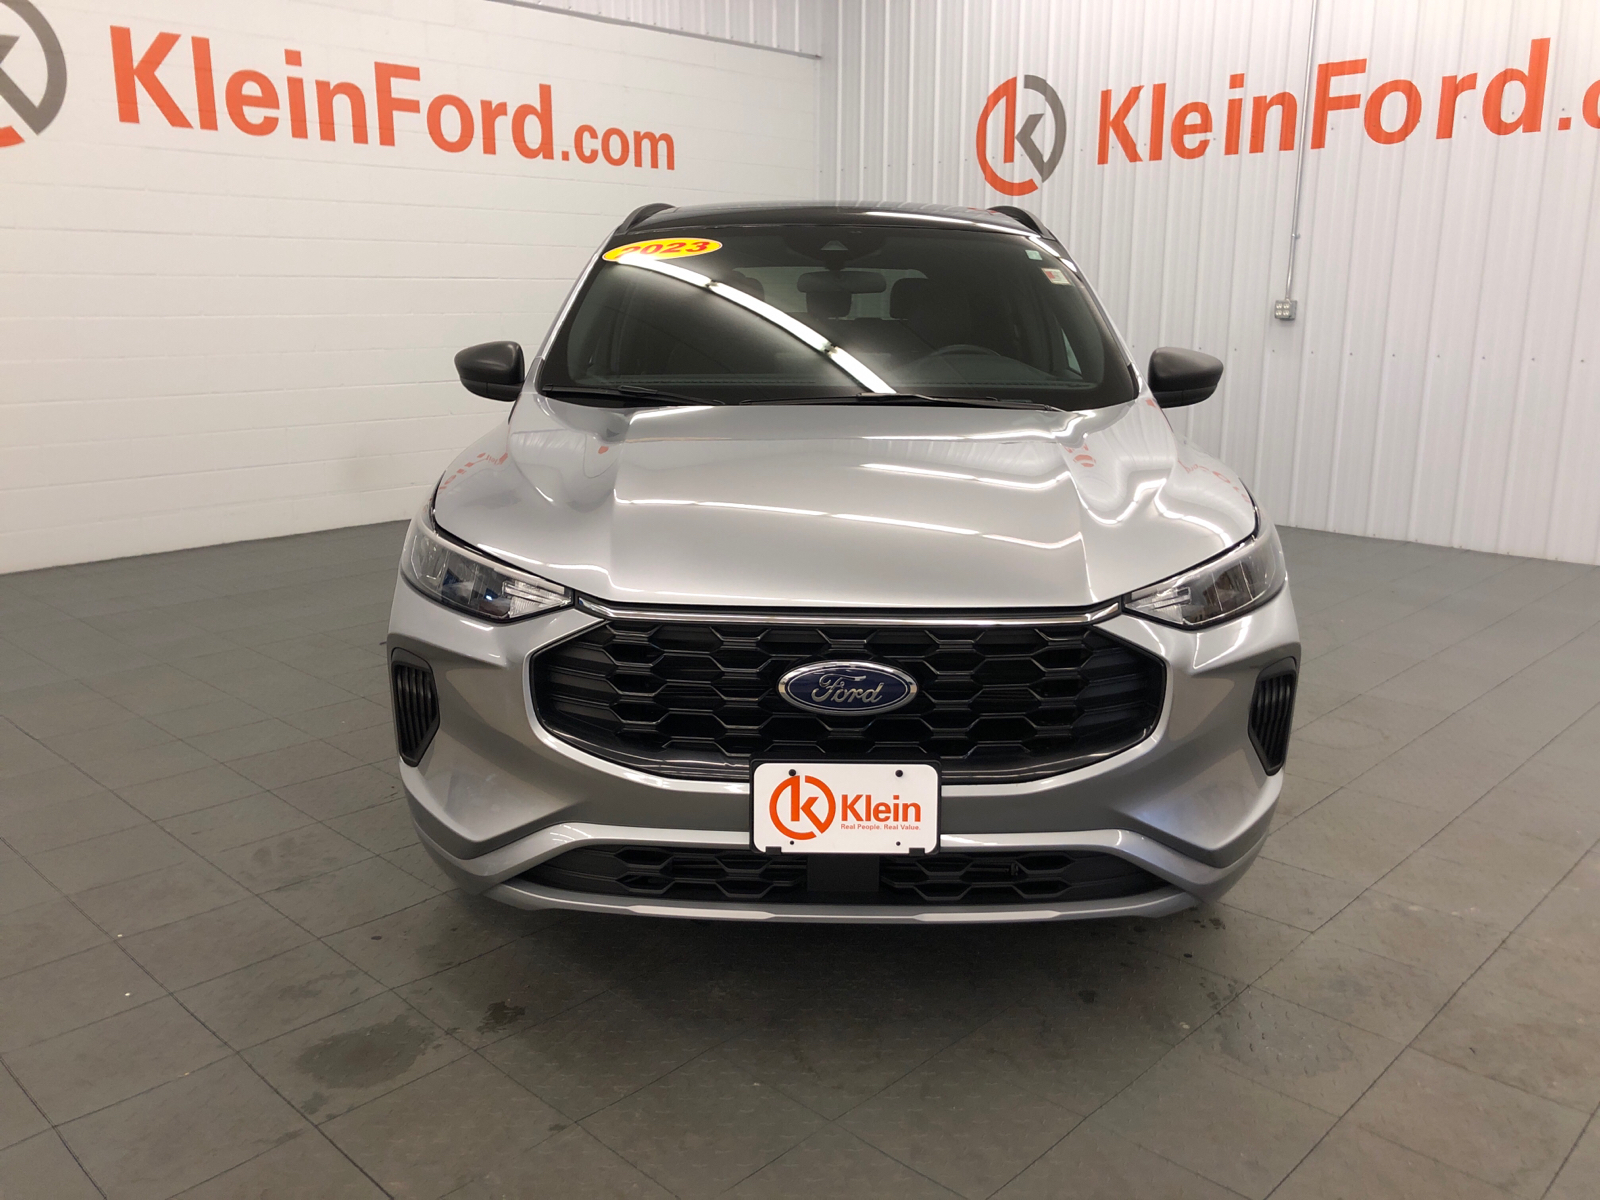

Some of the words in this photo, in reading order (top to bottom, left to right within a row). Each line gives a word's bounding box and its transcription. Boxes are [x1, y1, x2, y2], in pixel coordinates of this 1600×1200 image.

[109, 25, 676, 171] KleinFord.com
[614, 241, 711, 259] 2023
[811, 673, 885, 703] Ford
[841, 794, 921, 822] Klein
[857, 823, 882, 831] People.
